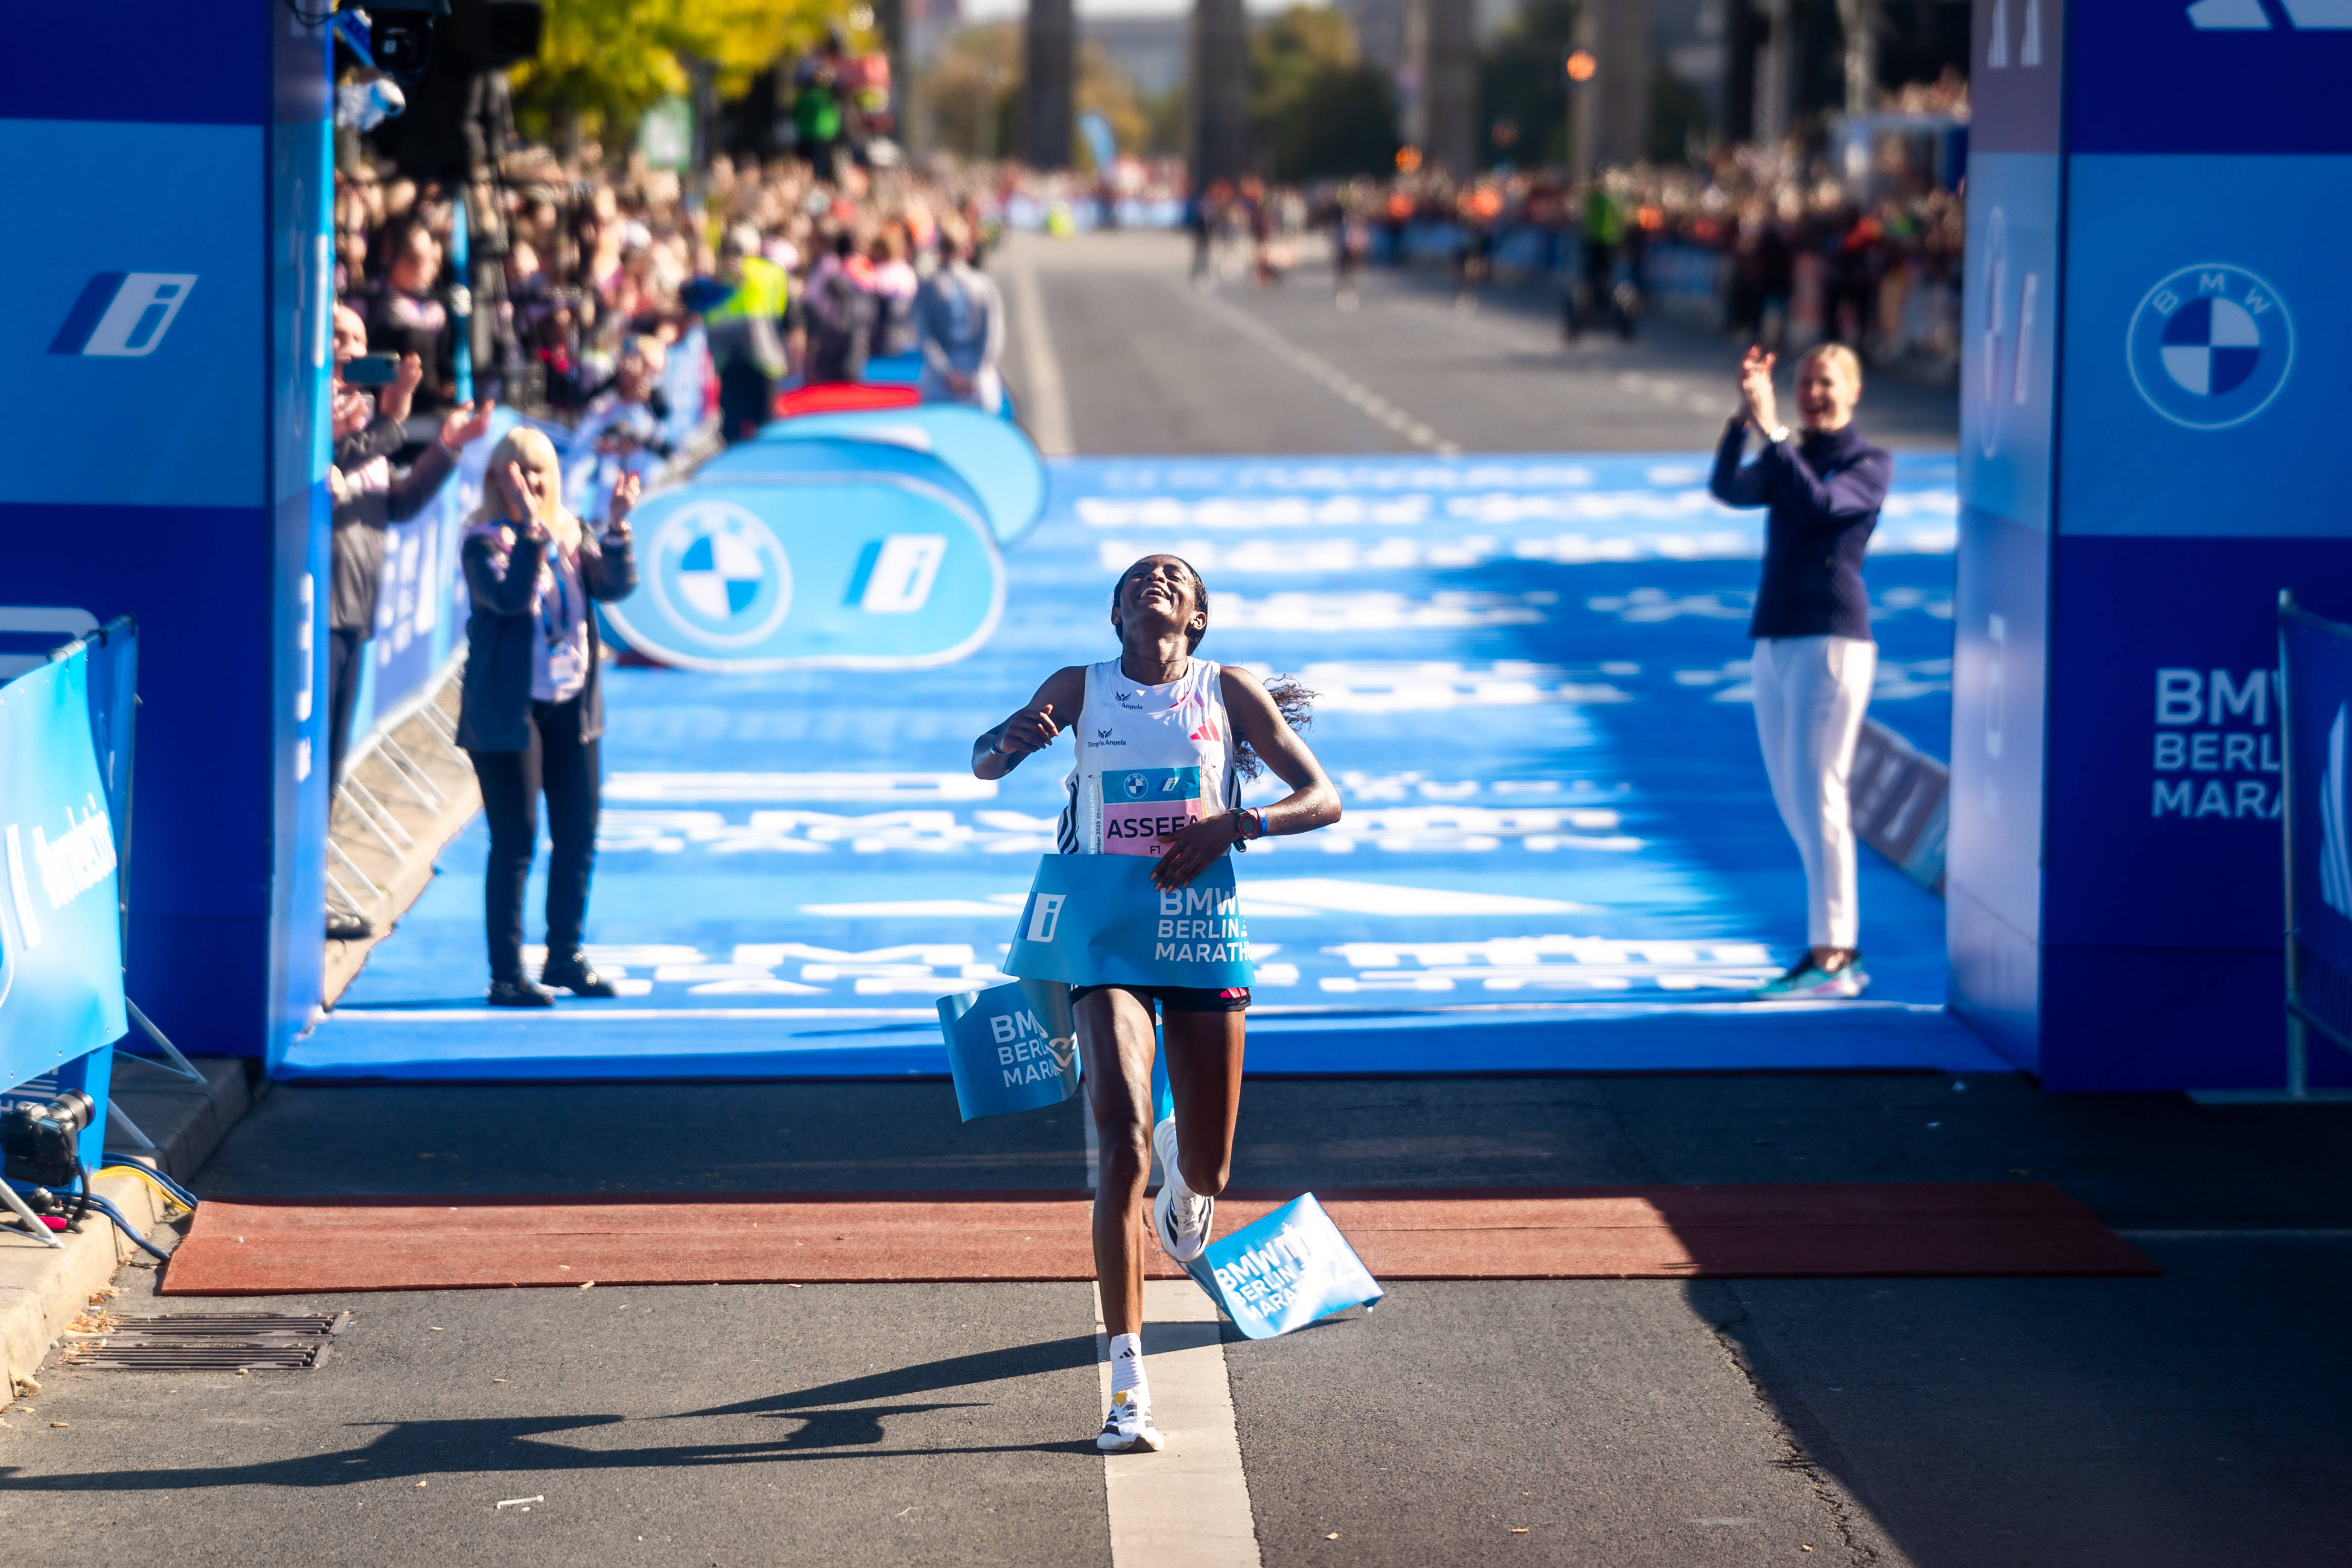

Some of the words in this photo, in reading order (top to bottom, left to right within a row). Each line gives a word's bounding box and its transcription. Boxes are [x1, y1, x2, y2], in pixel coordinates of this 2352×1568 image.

[2157, 668, 2280, 726] BM
[2154, 733, 2281, 770] BERL
[1150, 845, 1160, 854] F1
[1160, 886, 1236, 915] BMW
[1158, 918, 1239, 938] BERLIN
[1155, 941, 1252, 962] MARATH
[990, 1008, 1048, 1043] BM
[998, 1038, 1050, 1065] BERL
[1214, 1242, 1281, 1291] BMW
[1229, 1265, 1297, 1306] BERLIN
